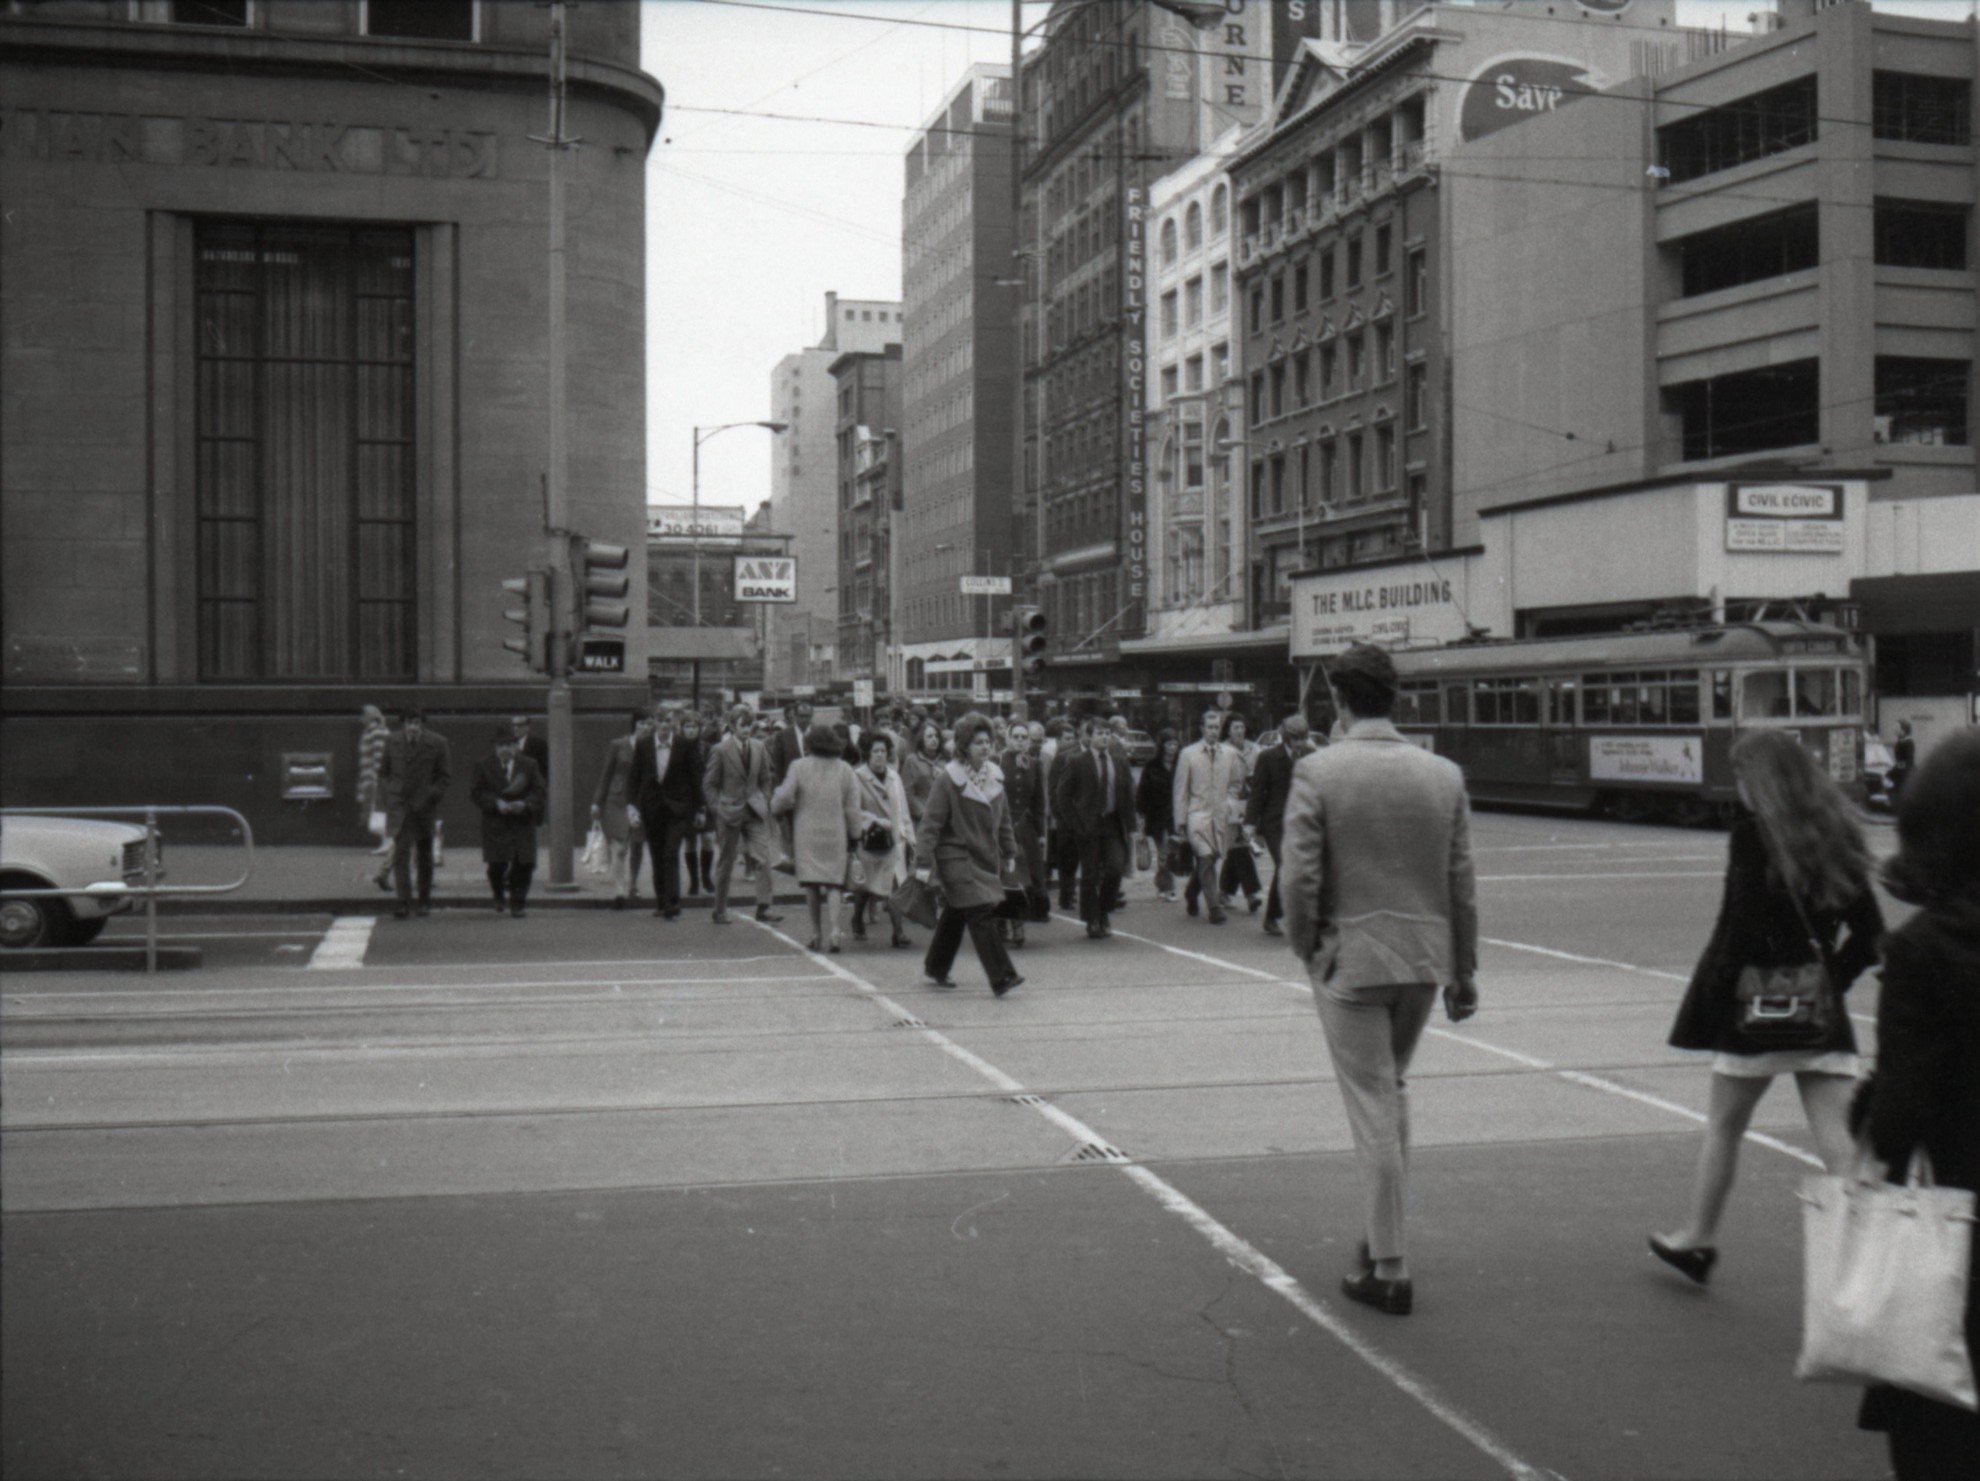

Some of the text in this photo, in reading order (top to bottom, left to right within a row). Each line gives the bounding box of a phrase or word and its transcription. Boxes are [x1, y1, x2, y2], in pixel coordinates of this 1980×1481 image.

[185, 115, 352, 174] BANK
[1128, 187, 1143, 596] FRIENDLY SOCIETIES HOUSE
[1748, 493, 1779, 507] CIVIL
[738, 561, 792, 580] ANZ
[742, 586, 790, 599] BANK
[1312, 592, 1338, 616] THE
[1379, 579, 1453, 610] BUILDING
[583, 655, 620, 669] WALK
